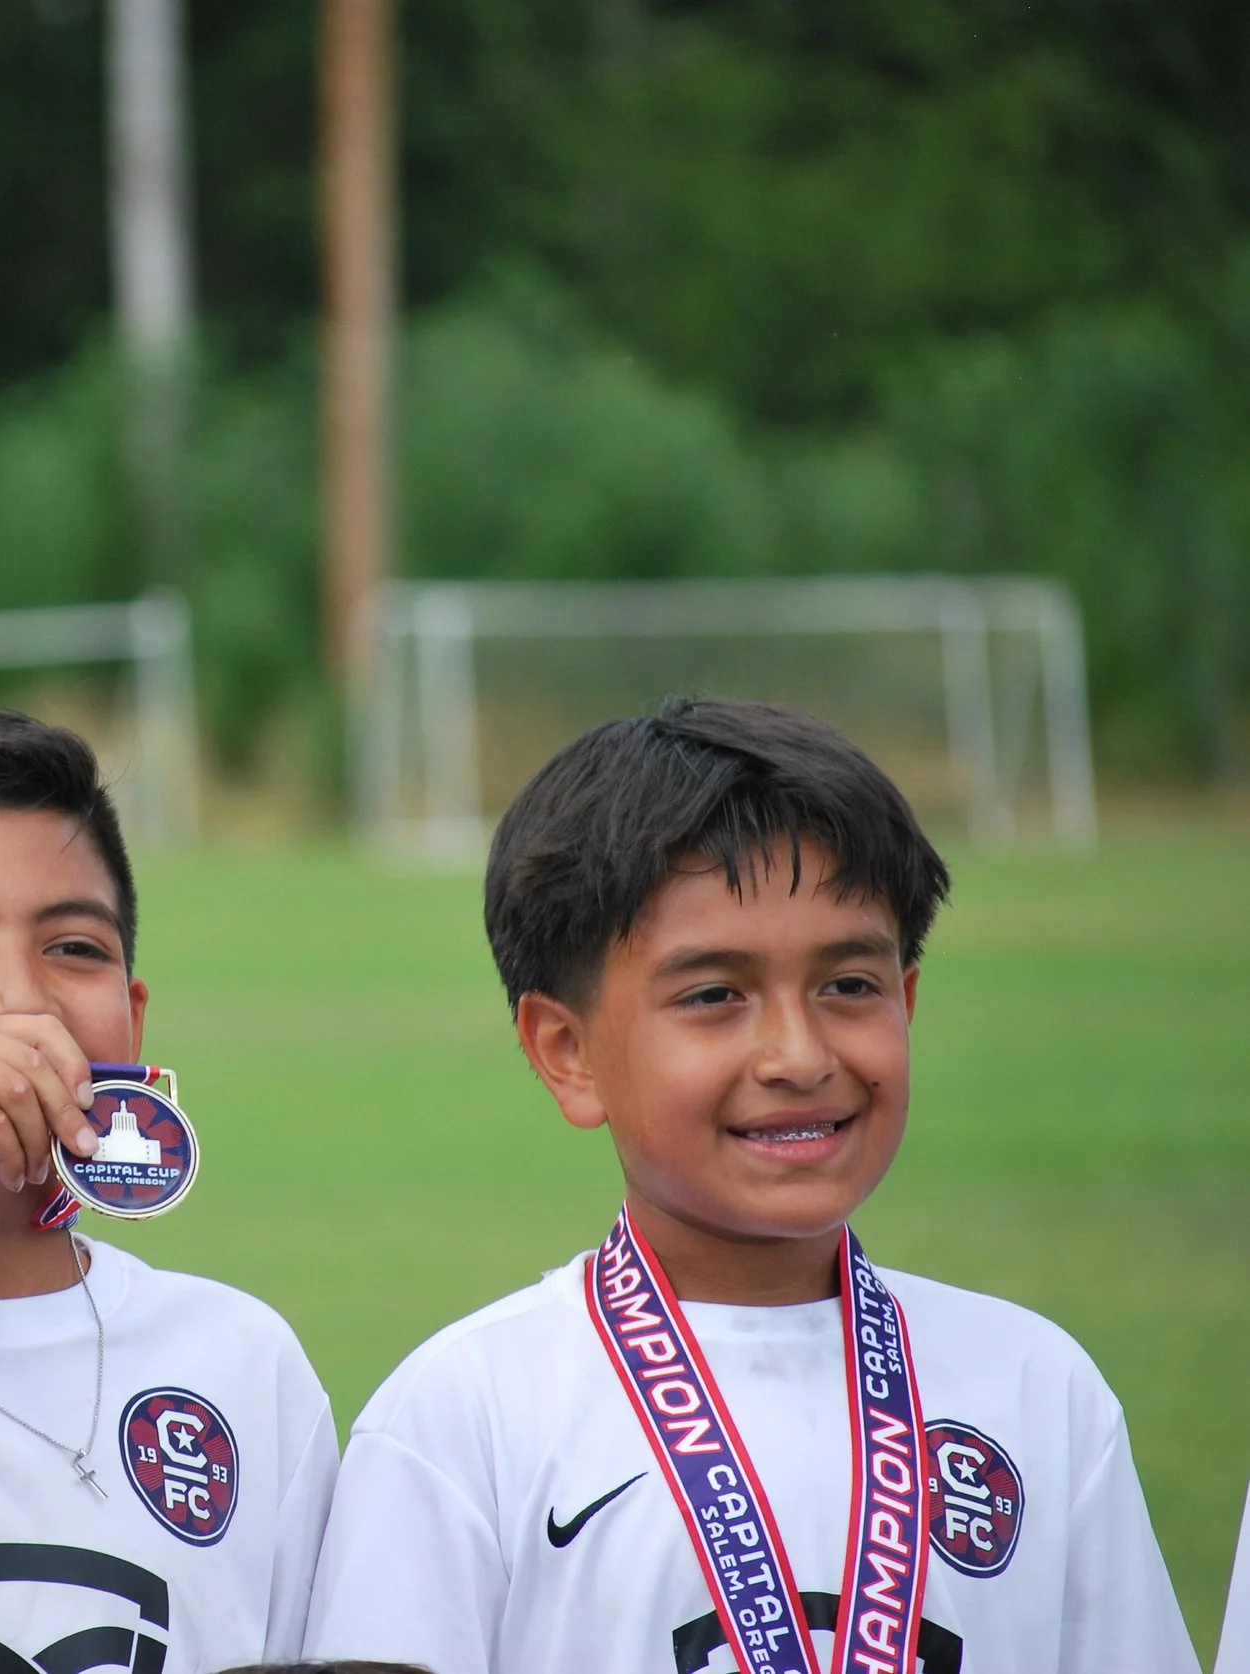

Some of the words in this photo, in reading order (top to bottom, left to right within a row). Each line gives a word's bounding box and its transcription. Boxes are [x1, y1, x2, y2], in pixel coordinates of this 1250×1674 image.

[74, 1164, 142, 1176] CAPITAL
[147, 1167, 180, 1178] CUP
[89, 1175, 123, 1184] SALEM,
[125, 1177, 166, 1186] OREGON
[854, 1252, 889, 1400] CAPITAL
[882, 1302, 902, 1374] SALEM,
[137, 1445, 157, 1463] 19
[212, 1464, 227, 1483] 93
[164, 1478, 210, 1520] FC
[995, 1496, 1012, 1515] 93
[945, 1508, 993, 1551] FC
[701, 1505, 745, 1600] SALEM,
[707, 1463, 789, 1652] CAPITAL
